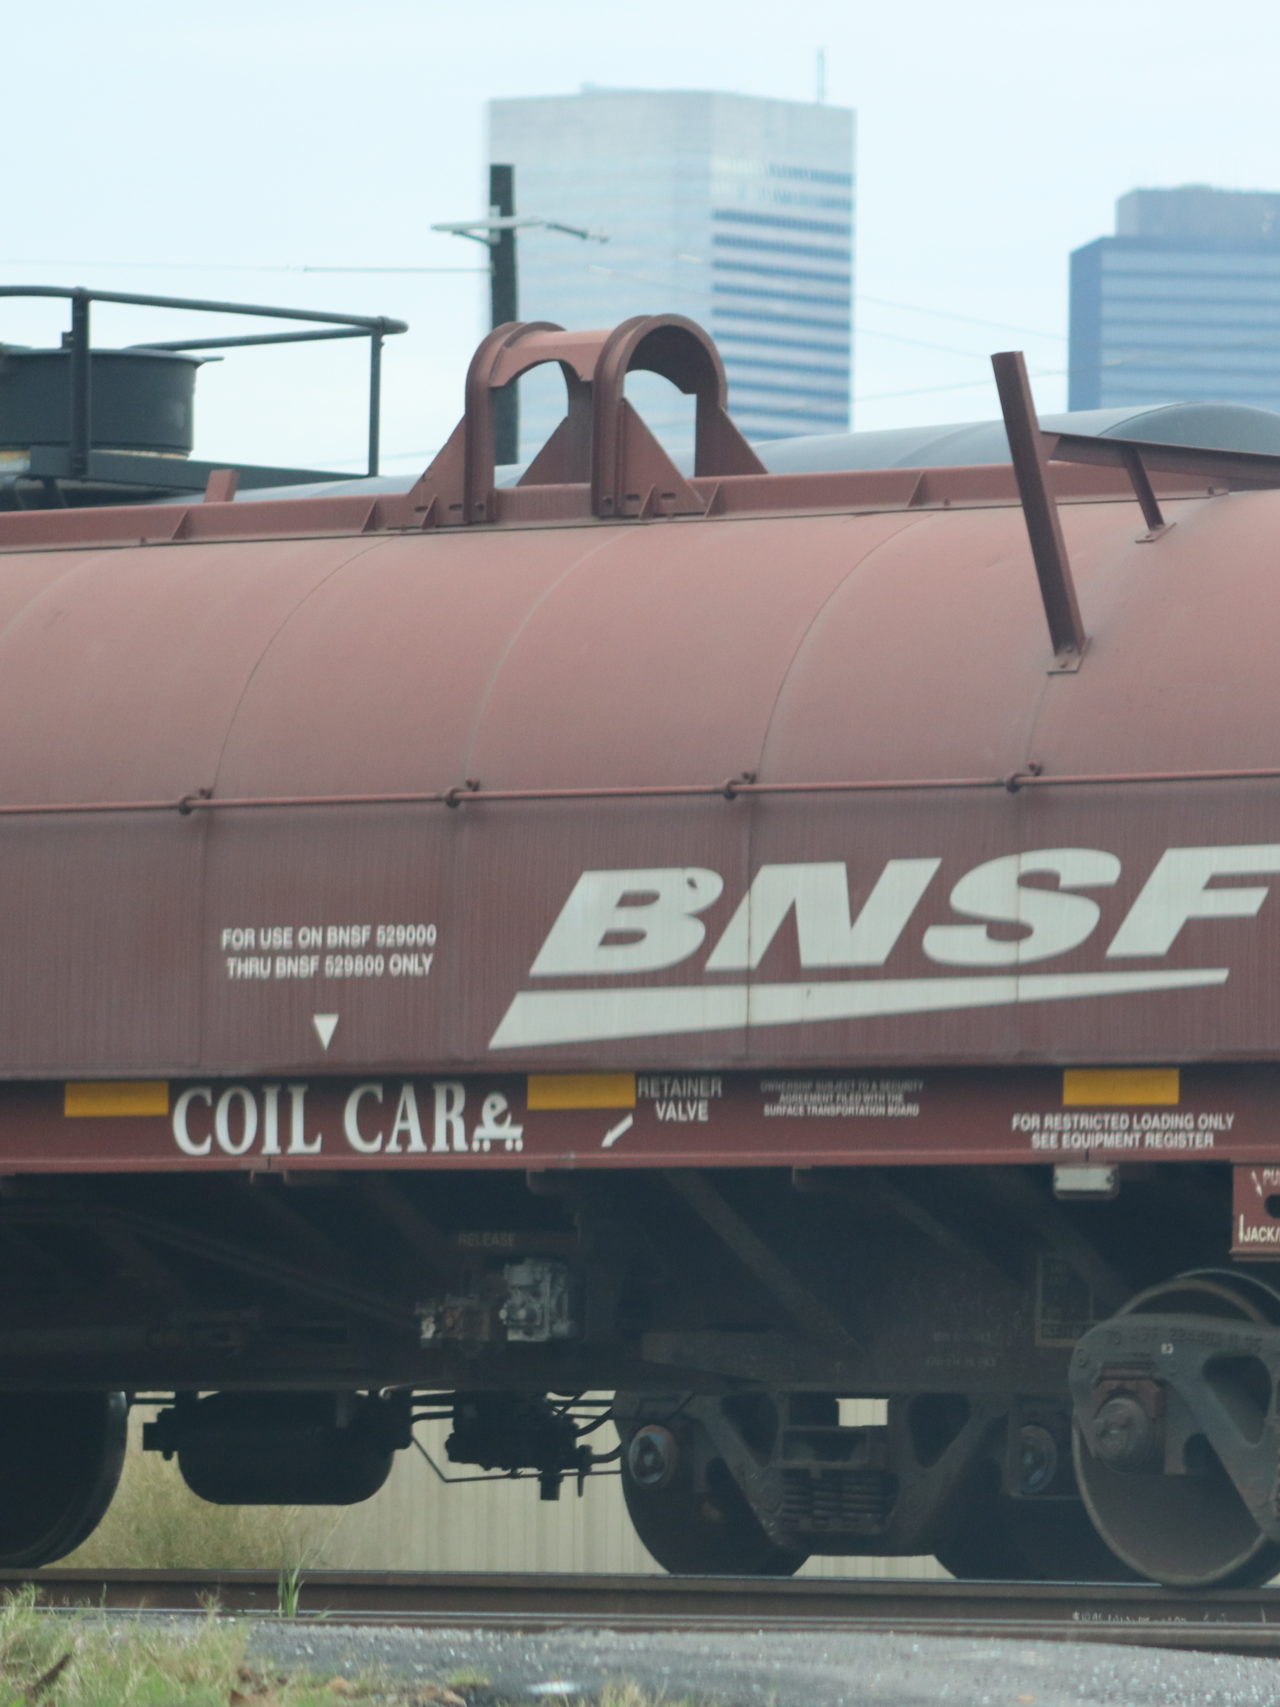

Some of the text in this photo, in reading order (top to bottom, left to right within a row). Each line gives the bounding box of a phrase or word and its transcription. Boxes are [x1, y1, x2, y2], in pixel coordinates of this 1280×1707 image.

[222, 924, 437, 951] FOR USE ON BNSF 529000
[227, 957, 271, 979] THRU
[275, 956, 320, 978] BNSF
[389, 953, 433, 976] ONLY
[638, 1076, 722, 1098] RETAINER
[172, 1082, 469, 1156] COIL CAR
[655, 1099, 709, 1122] VALVE
[763, 1103, 805, 1117] SURFACE
[887, 1103, 920, 1117] BOARD
[1011, 1113, 1234, 1131] FOR RESTRICTED LOADING ONLY
[1031, 1131, 1214, 1149] SEE EQUIPMENT REGISTER
[458, 1231, 516, 1248] RELEASE
